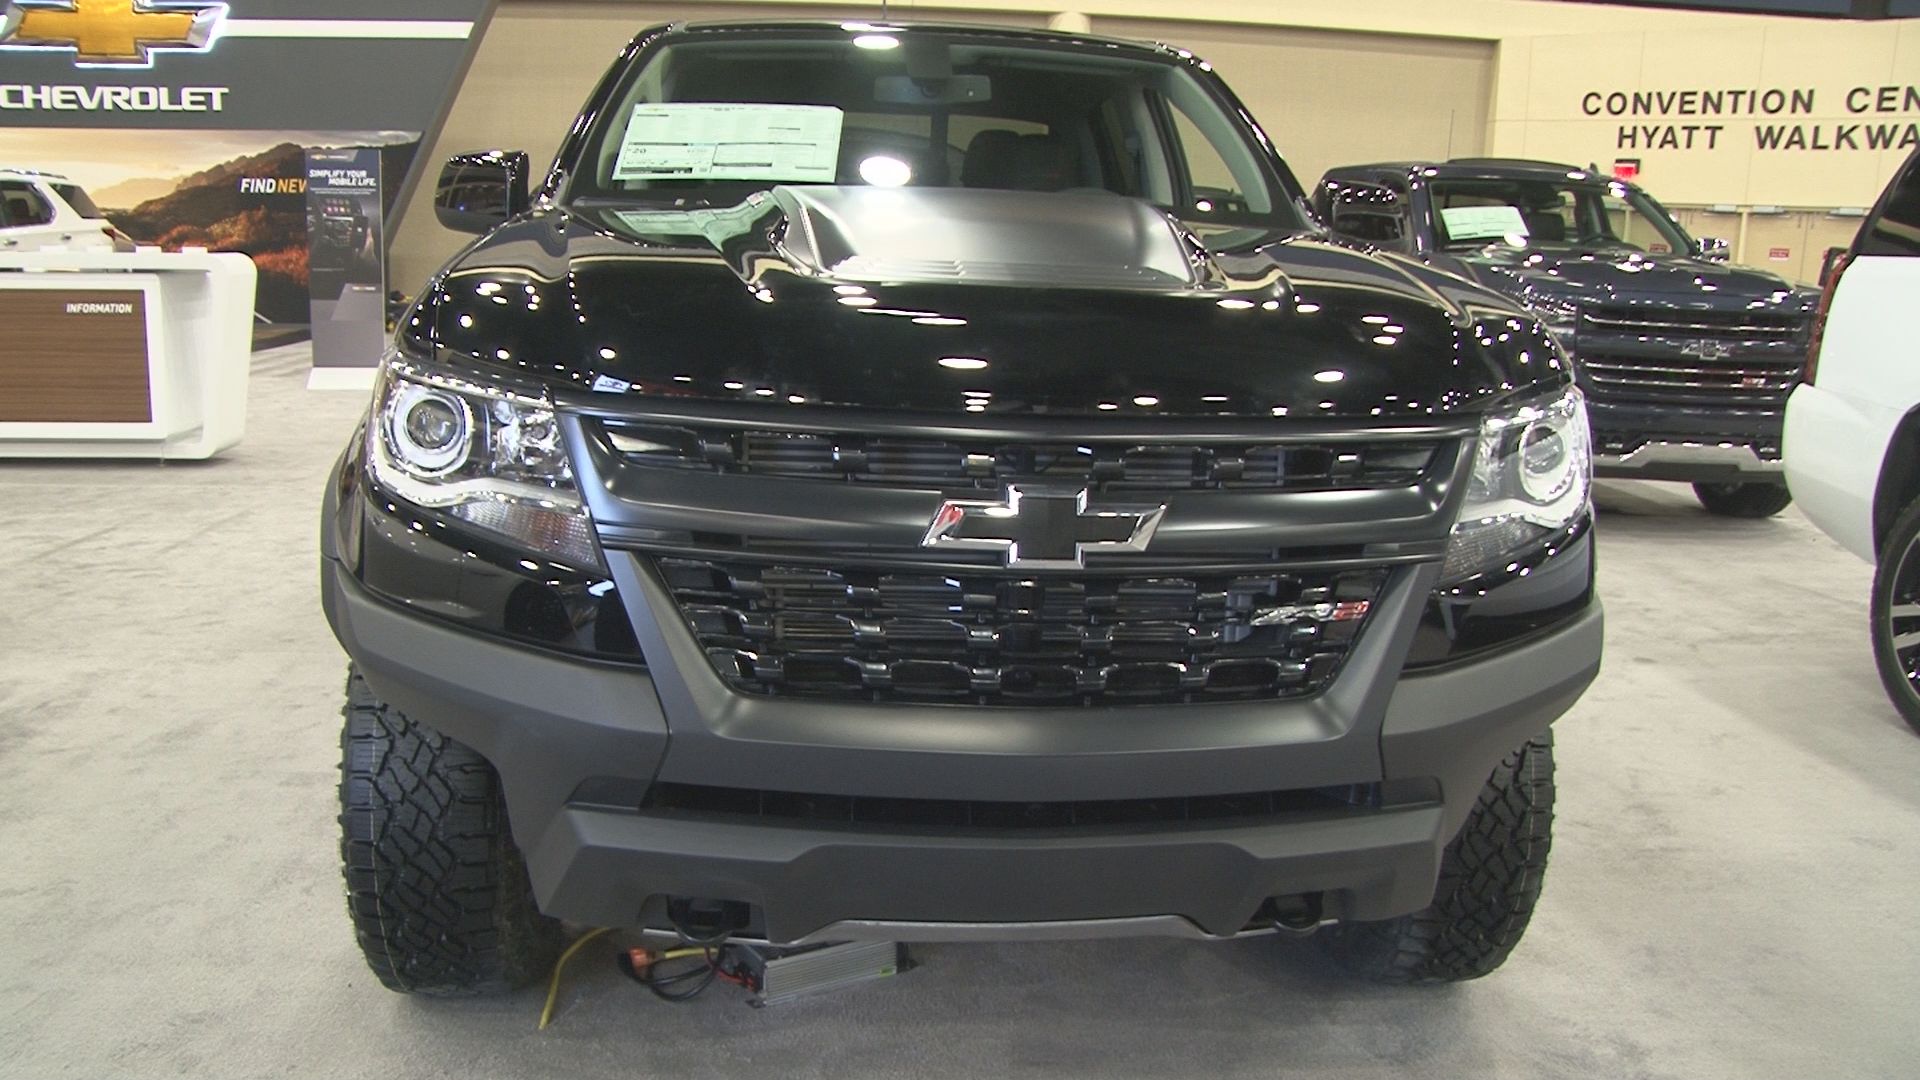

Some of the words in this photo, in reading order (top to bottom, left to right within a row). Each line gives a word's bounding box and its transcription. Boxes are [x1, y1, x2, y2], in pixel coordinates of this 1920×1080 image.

[0, 84, 229, 111] CHEVROLET
[1582, 88, 1815, 115] CONVENTION
[1846, 86, 1920, 114] CEN
[1617, 125, 1723, 150] HYATT
[1755, 123, 1920, 150] WALKWA
[309, 169, 345, 178] SIMPLIFY
[346, 169, 368, 178] YOUR
[328, 177, 357, 187] MOBILE
[240, 177, 276, 194] FIND
[66, 303, 133, 314] INFORMATION
